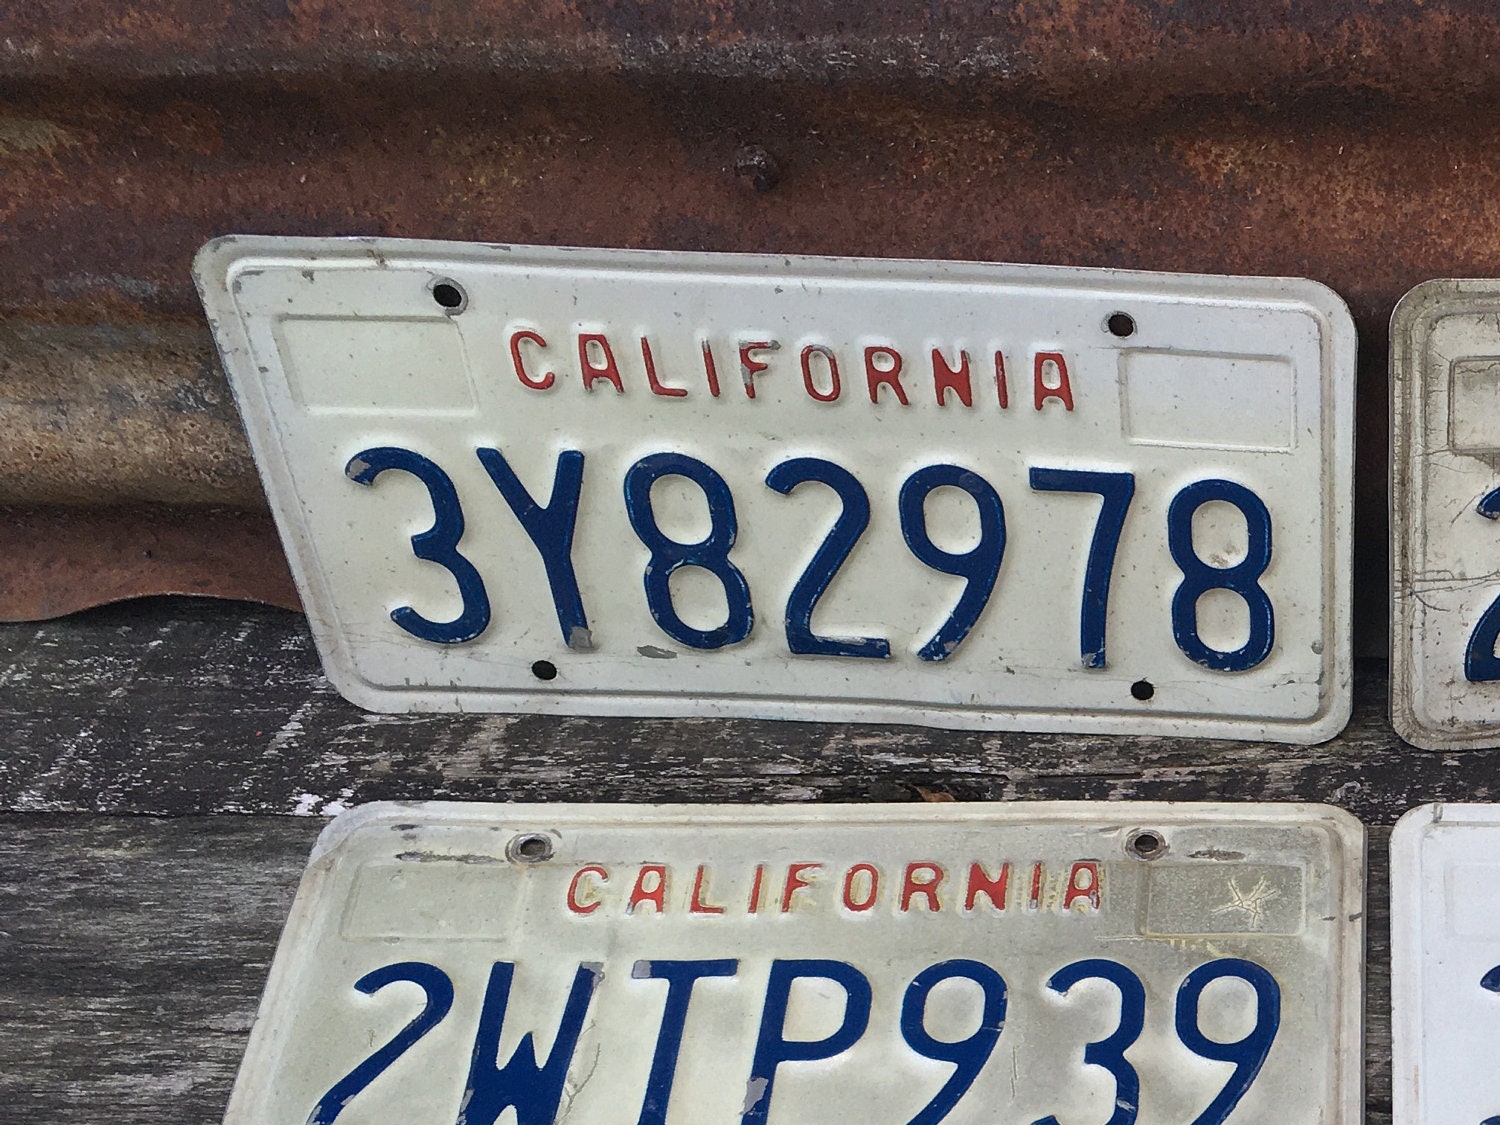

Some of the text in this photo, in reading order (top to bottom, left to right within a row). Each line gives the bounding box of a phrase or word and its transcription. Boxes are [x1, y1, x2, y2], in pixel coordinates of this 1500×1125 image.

[509, 328, 1075, 411] CALIFORNIA
[345, 446, 1276, 672] 3Y82978
[566, 861, 1104, 914] CALIFORNIA
